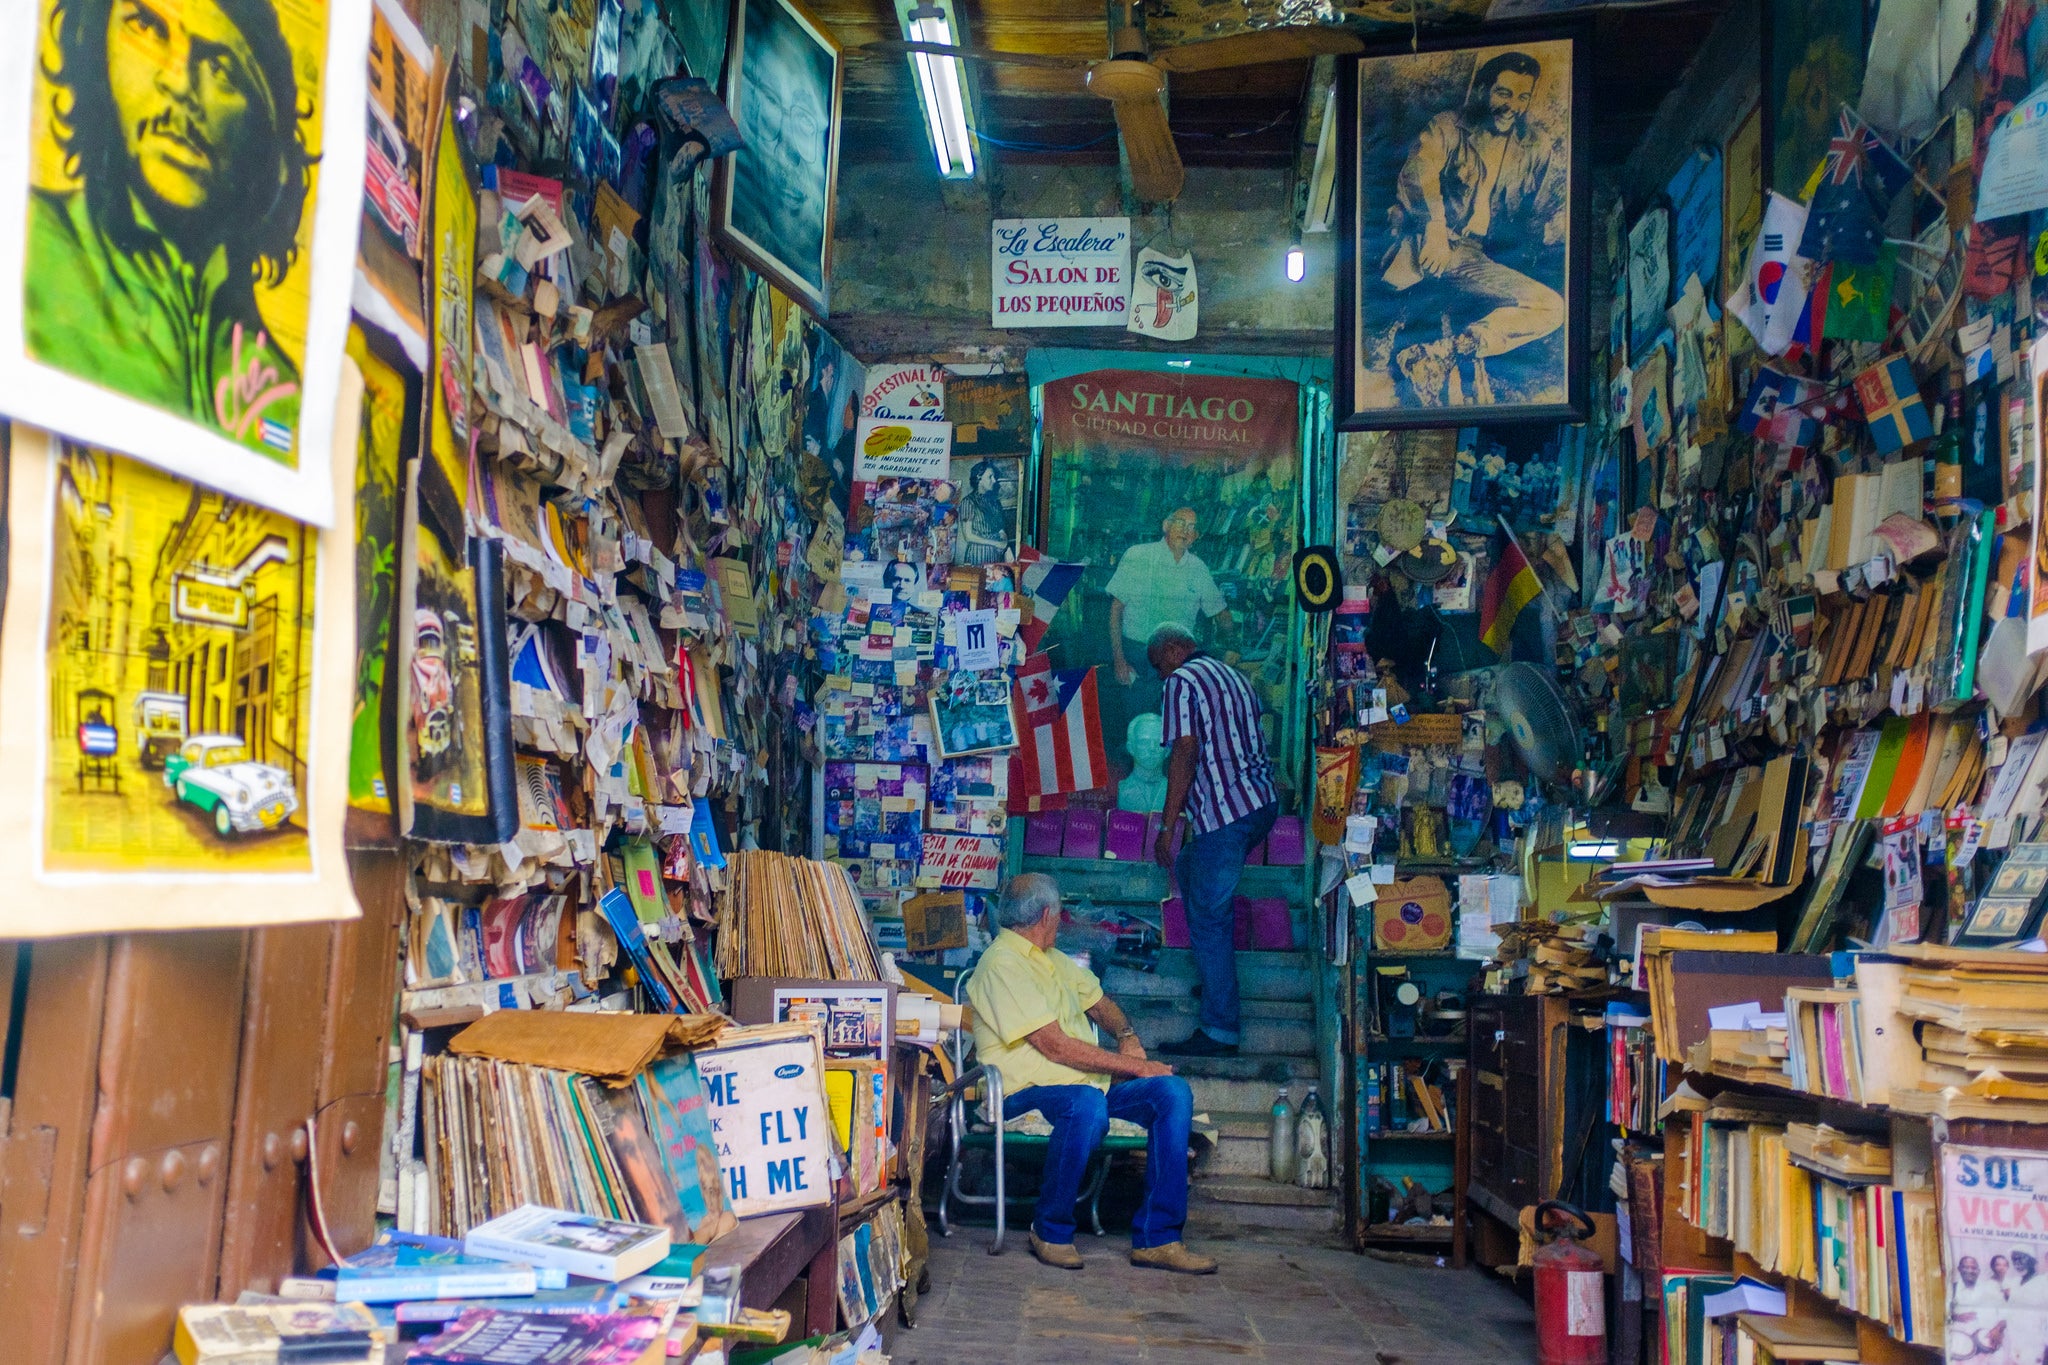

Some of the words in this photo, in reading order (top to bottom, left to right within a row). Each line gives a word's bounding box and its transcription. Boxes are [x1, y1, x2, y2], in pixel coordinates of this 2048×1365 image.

[1006, 259, 1088, 285] SALON
[1095, 267, 1120, 284] DE
[998, 296, 1031, 313] LOS
[1036, 292, 1126, 315] PEQUEÑOS
[872, 368, 927, 401] FESTIVAL
[1071, 384, 1255, 423] SANTIAGO
[1072, 412, 1147, 436] CIUDAD
[1153, 420, 1251, 443] CULTURAL
[880, 456, 927, 465] IMPORTANTE
[759, 1106, 808, 1146] FLY
[767, 1156, 809, 1195] ME
